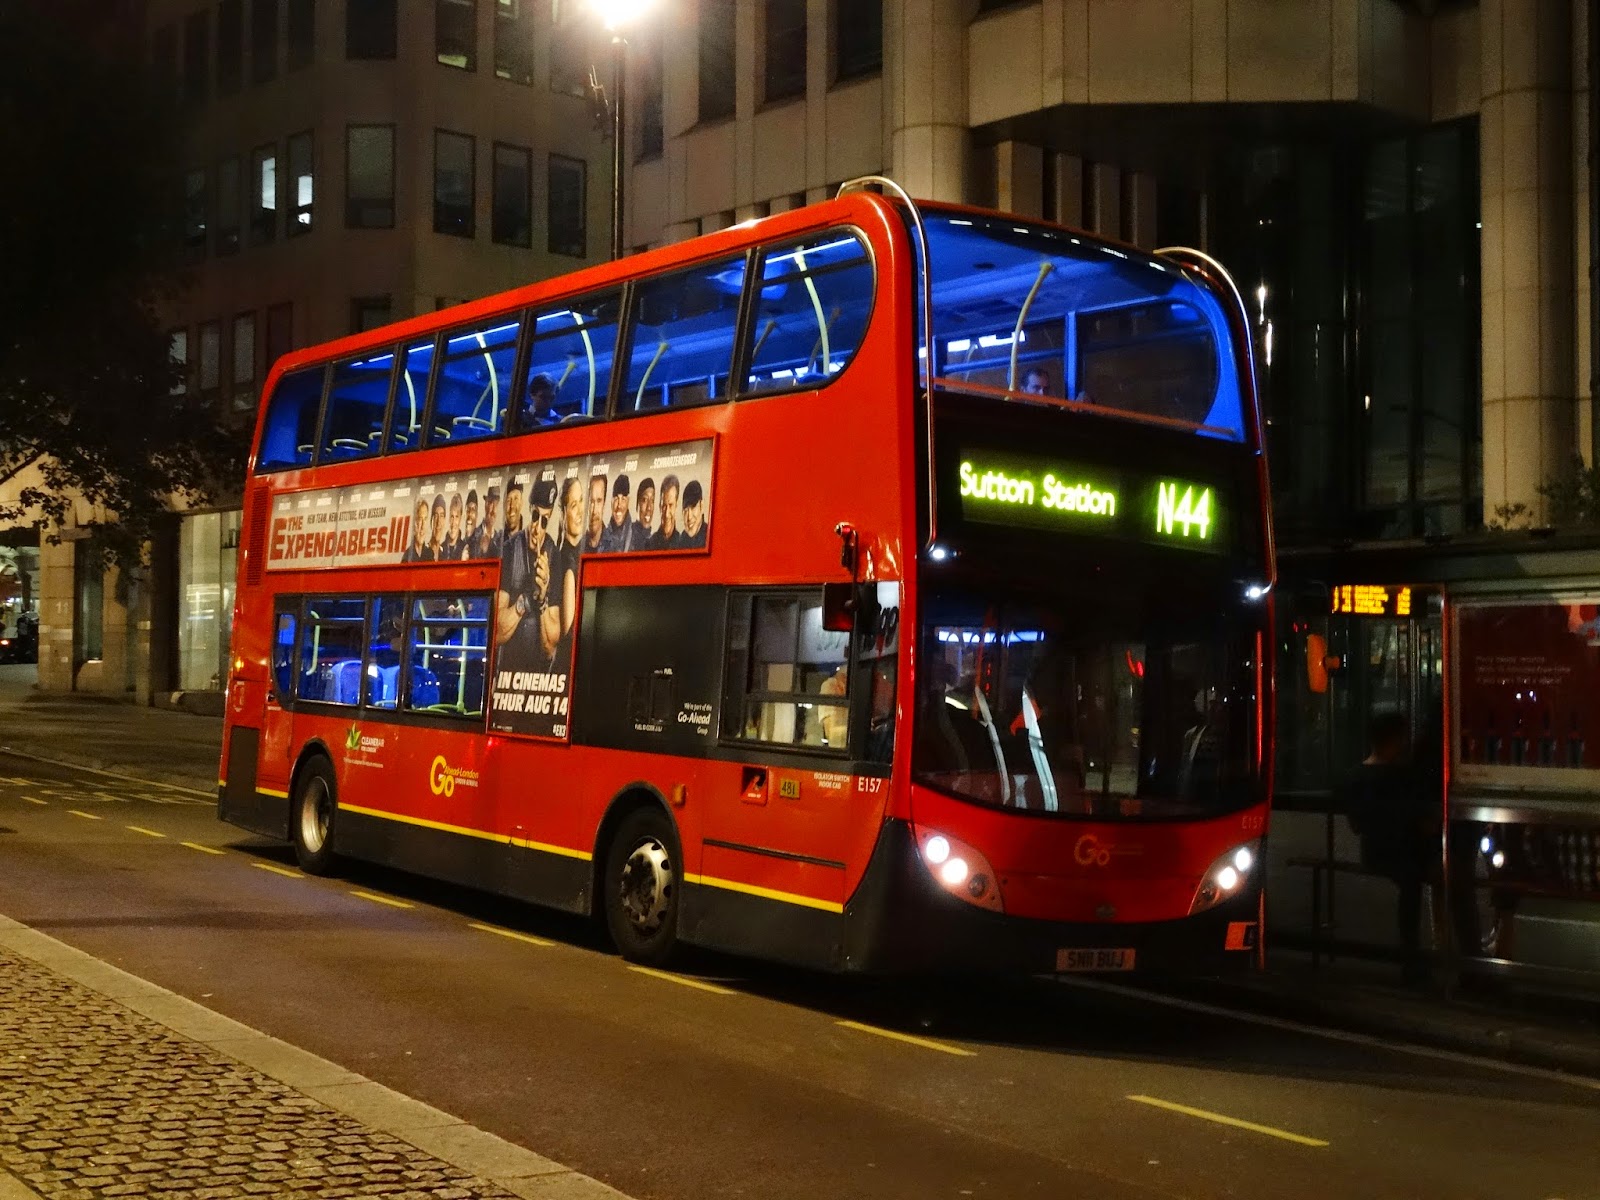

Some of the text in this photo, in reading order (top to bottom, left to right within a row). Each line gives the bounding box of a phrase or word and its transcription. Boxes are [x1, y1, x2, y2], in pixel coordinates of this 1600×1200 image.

[959, 461, 1116, 516] Sutton Station
[1156, 481, 1210, 539] N44
[287, 515, 304, 531] THE
[497, 671, 567, 693] IN CINEMAS
[493, 692, 569, 716] THUR AUG 14
[677, 711, 711, 725] Go-Ahead
[430, 755, 455, 798] Go
[857, 776, 882, 794] E157
